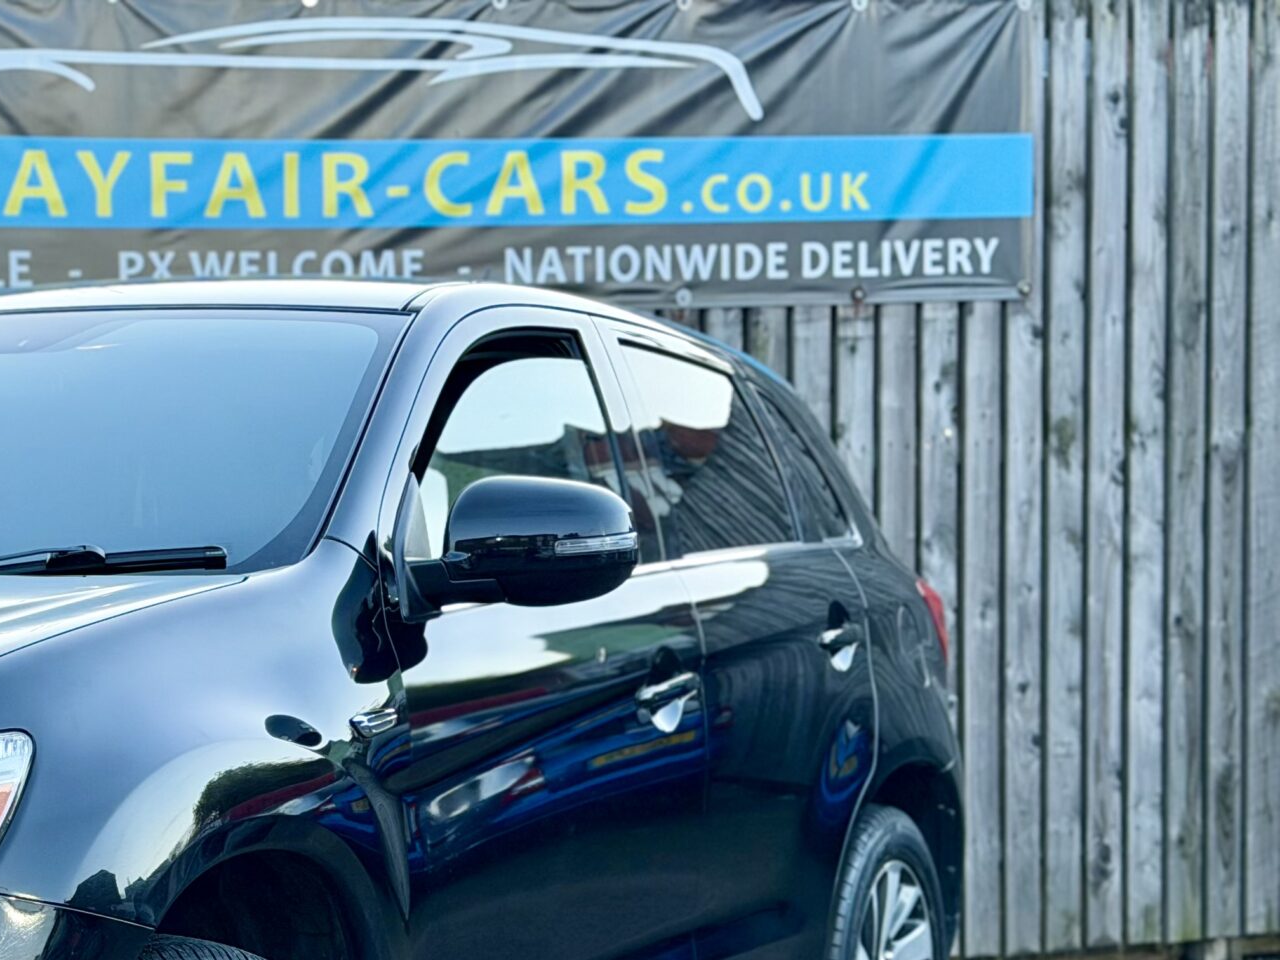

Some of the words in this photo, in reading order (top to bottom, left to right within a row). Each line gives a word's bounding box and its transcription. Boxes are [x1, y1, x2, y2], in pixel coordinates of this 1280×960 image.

[118, 249, 176, 281] PX
[188, 249, 424, 280] WELCOME
[504, 242, 789, 285] NATIONWIDE
[801, 237, 1000, 280] DELIVERY
